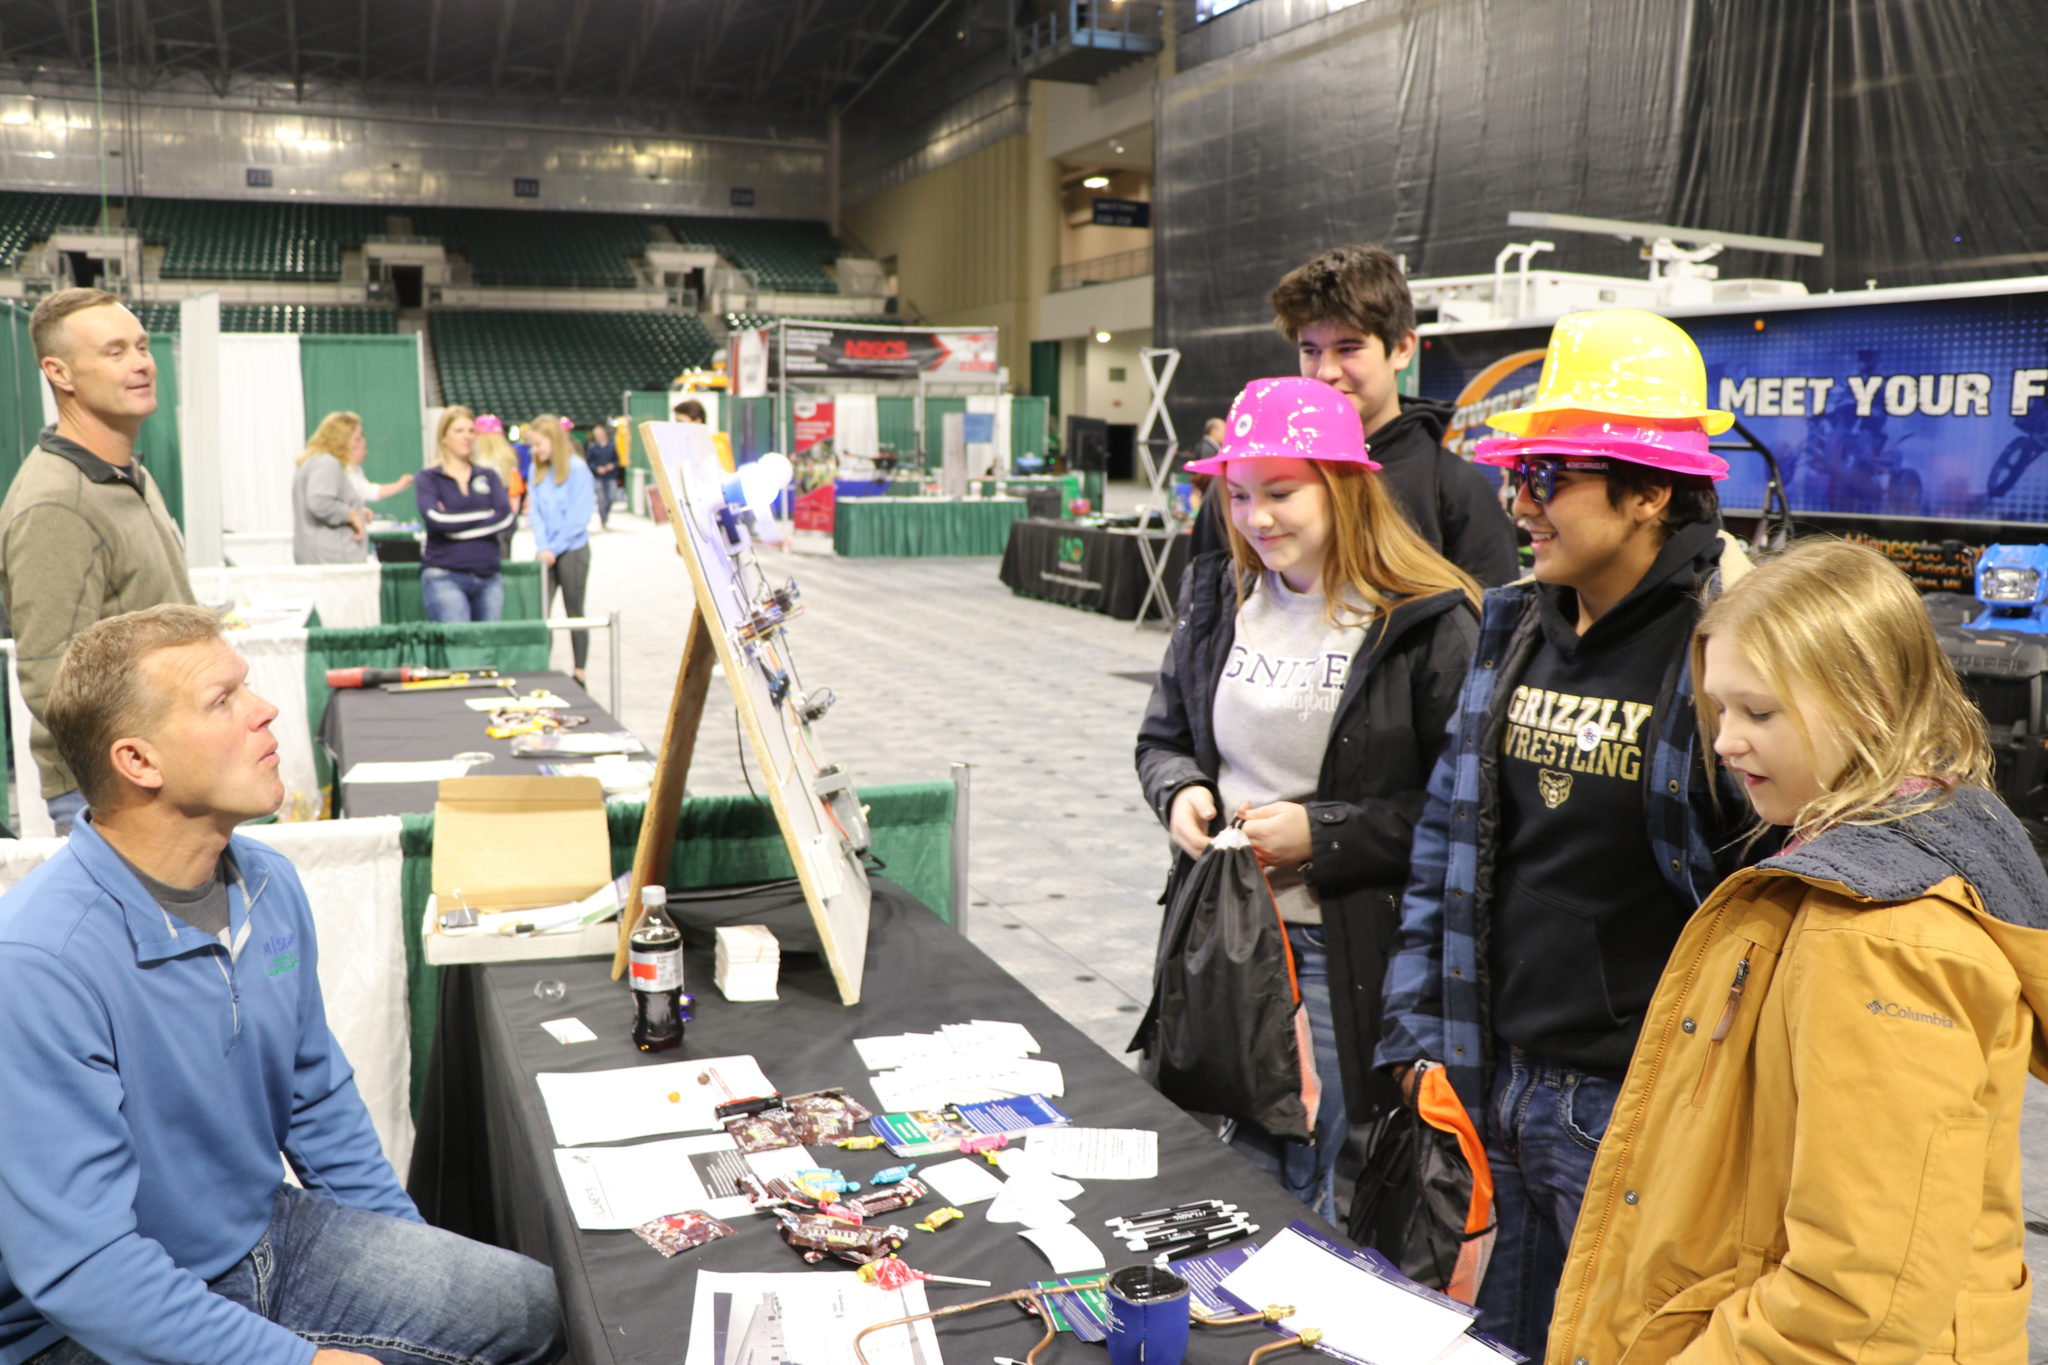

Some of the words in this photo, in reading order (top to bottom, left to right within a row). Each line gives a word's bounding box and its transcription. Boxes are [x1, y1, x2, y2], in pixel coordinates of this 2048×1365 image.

[1719, 375, 1834, 417] MEET
[1847, 372, 1992, 417] YOUR
[1507, 684, 1654, 745] GRIZZLY
[1504, 722, 1643, 782] WRESTLING
[1884, 1002, 1954, 1029] Columbia
